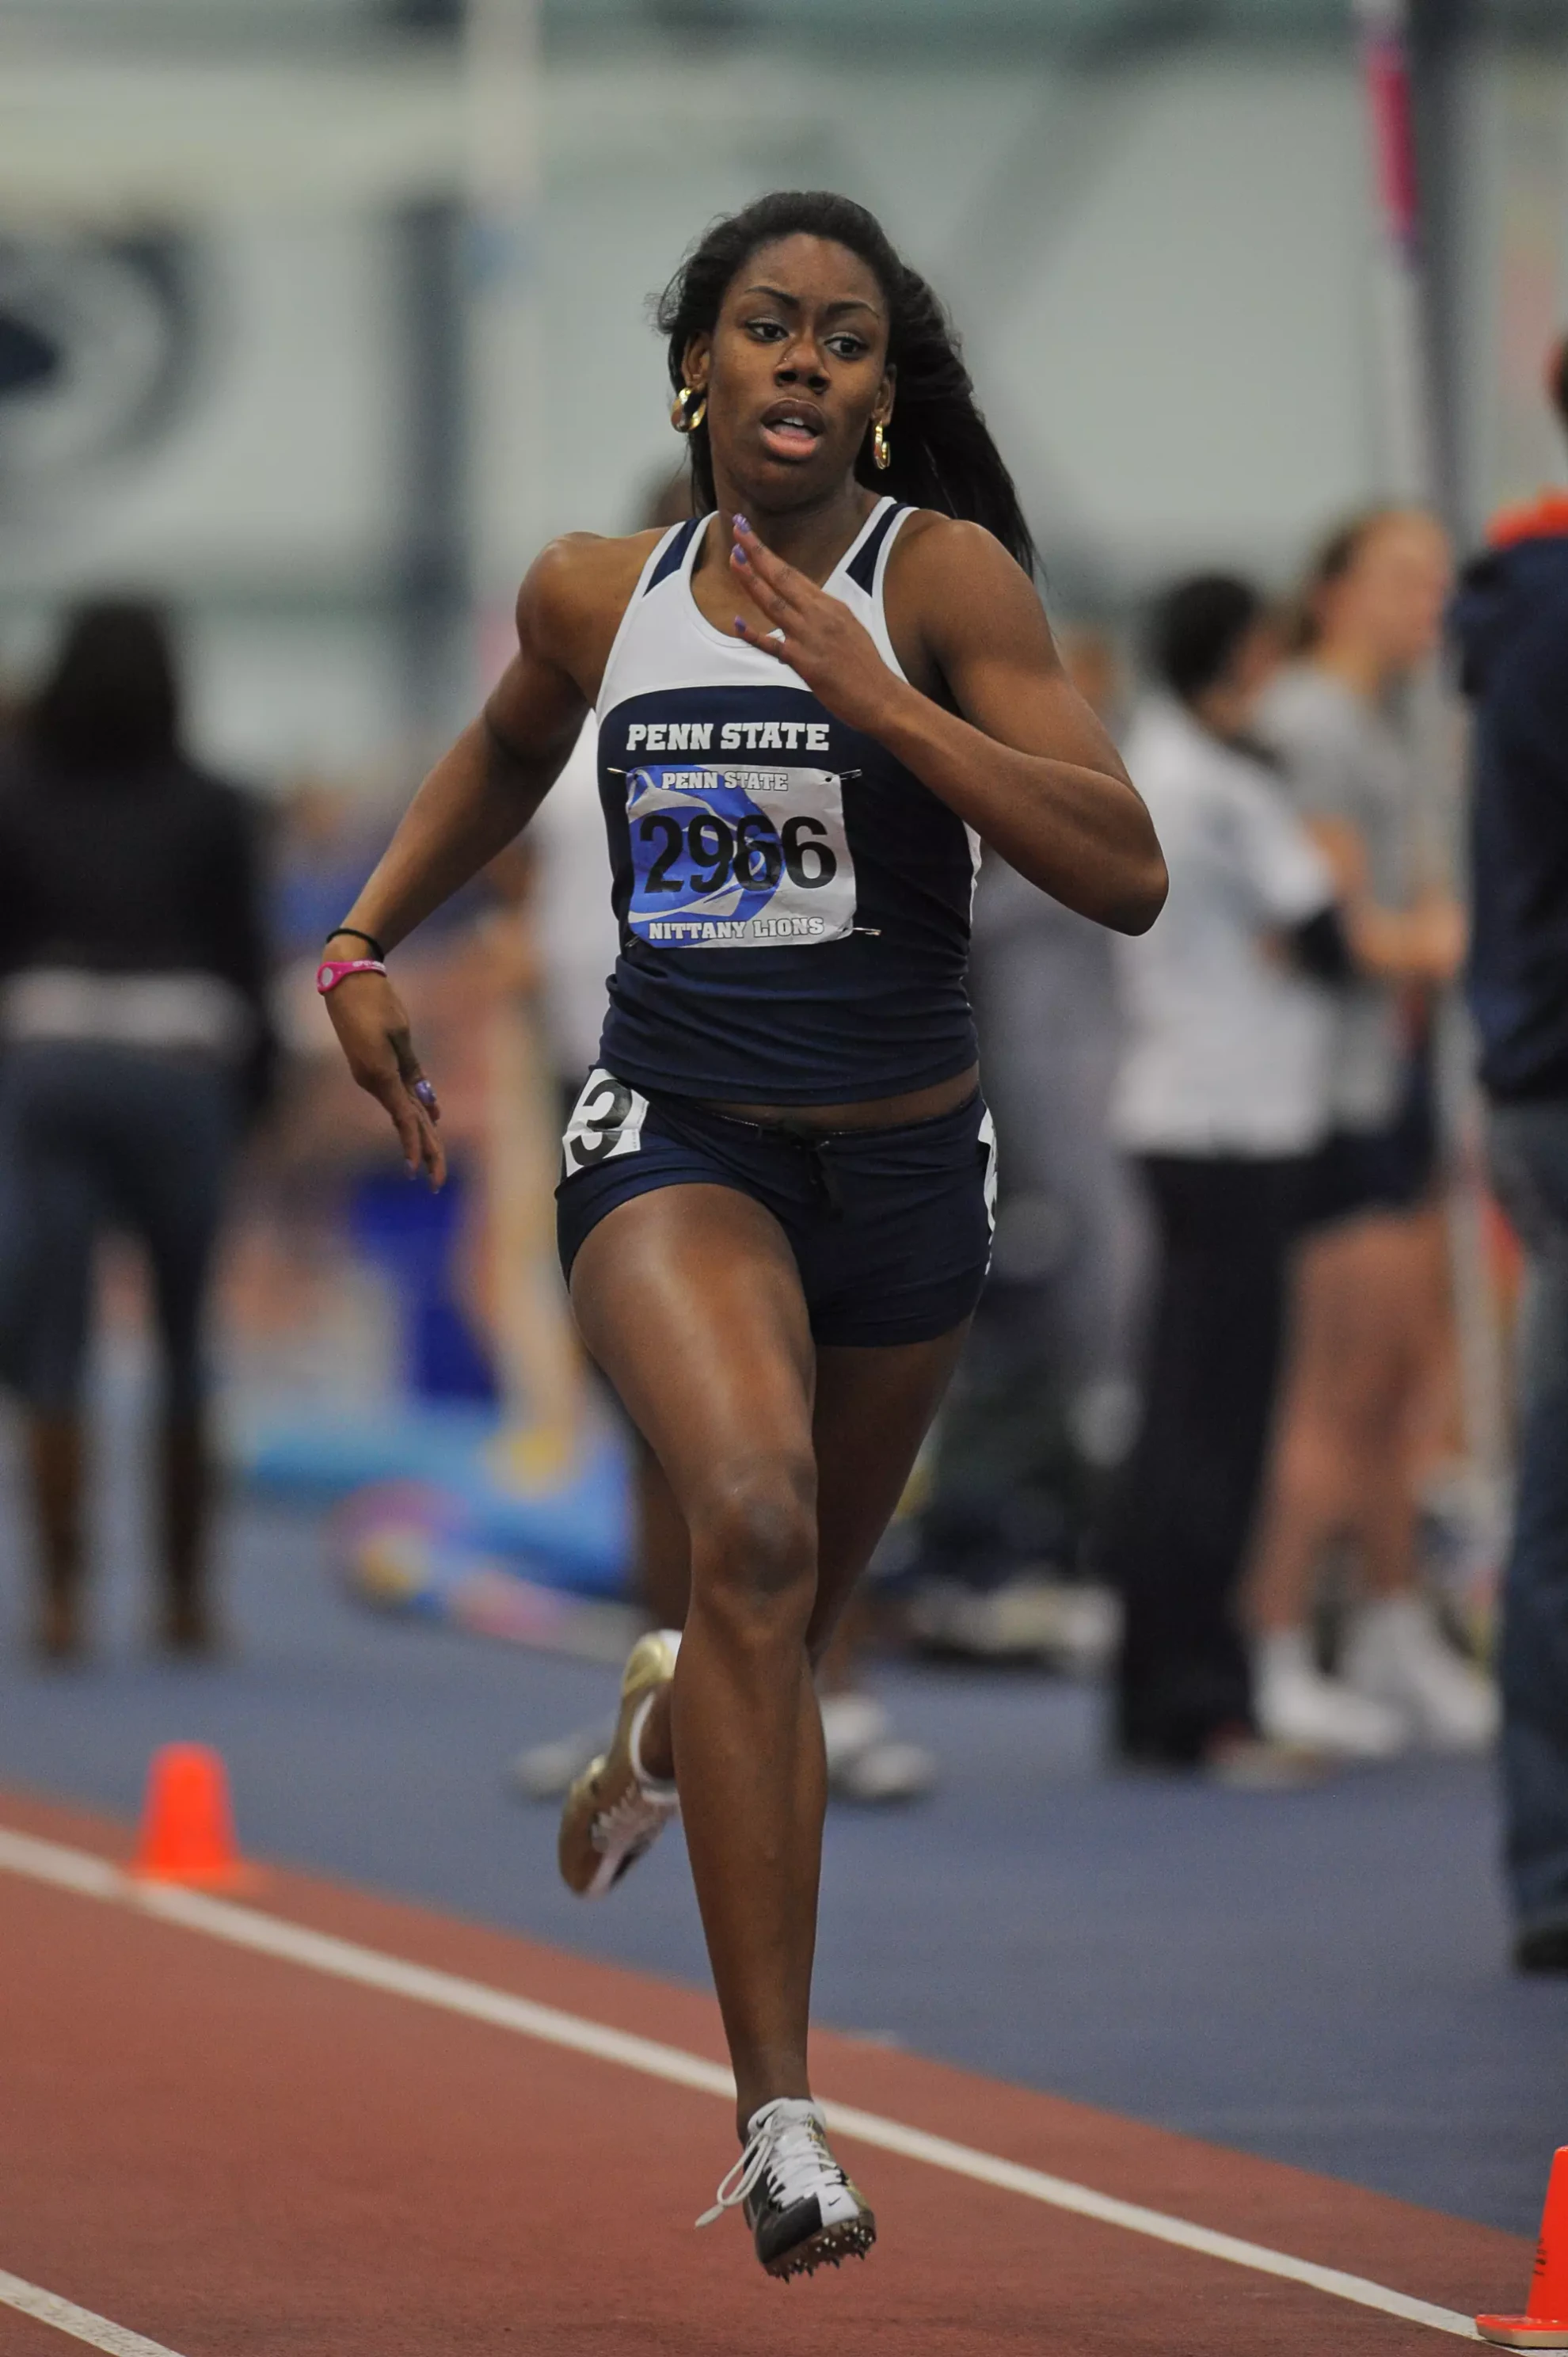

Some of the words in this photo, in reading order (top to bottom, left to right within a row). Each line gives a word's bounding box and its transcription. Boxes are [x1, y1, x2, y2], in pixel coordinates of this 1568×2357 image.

[626, 723, 714, 751] PENN
[721, 722, 830, 751] STATE
[662, 771, 719, 790] PENN
[724, 771, 789, 791] STATE
[640, 814, 837, 893] 2966
[648, 920, 748, 940] NITTANY
[753, 916, 825, 938] LIONS
[569, 1079, 634, 1167] 3
